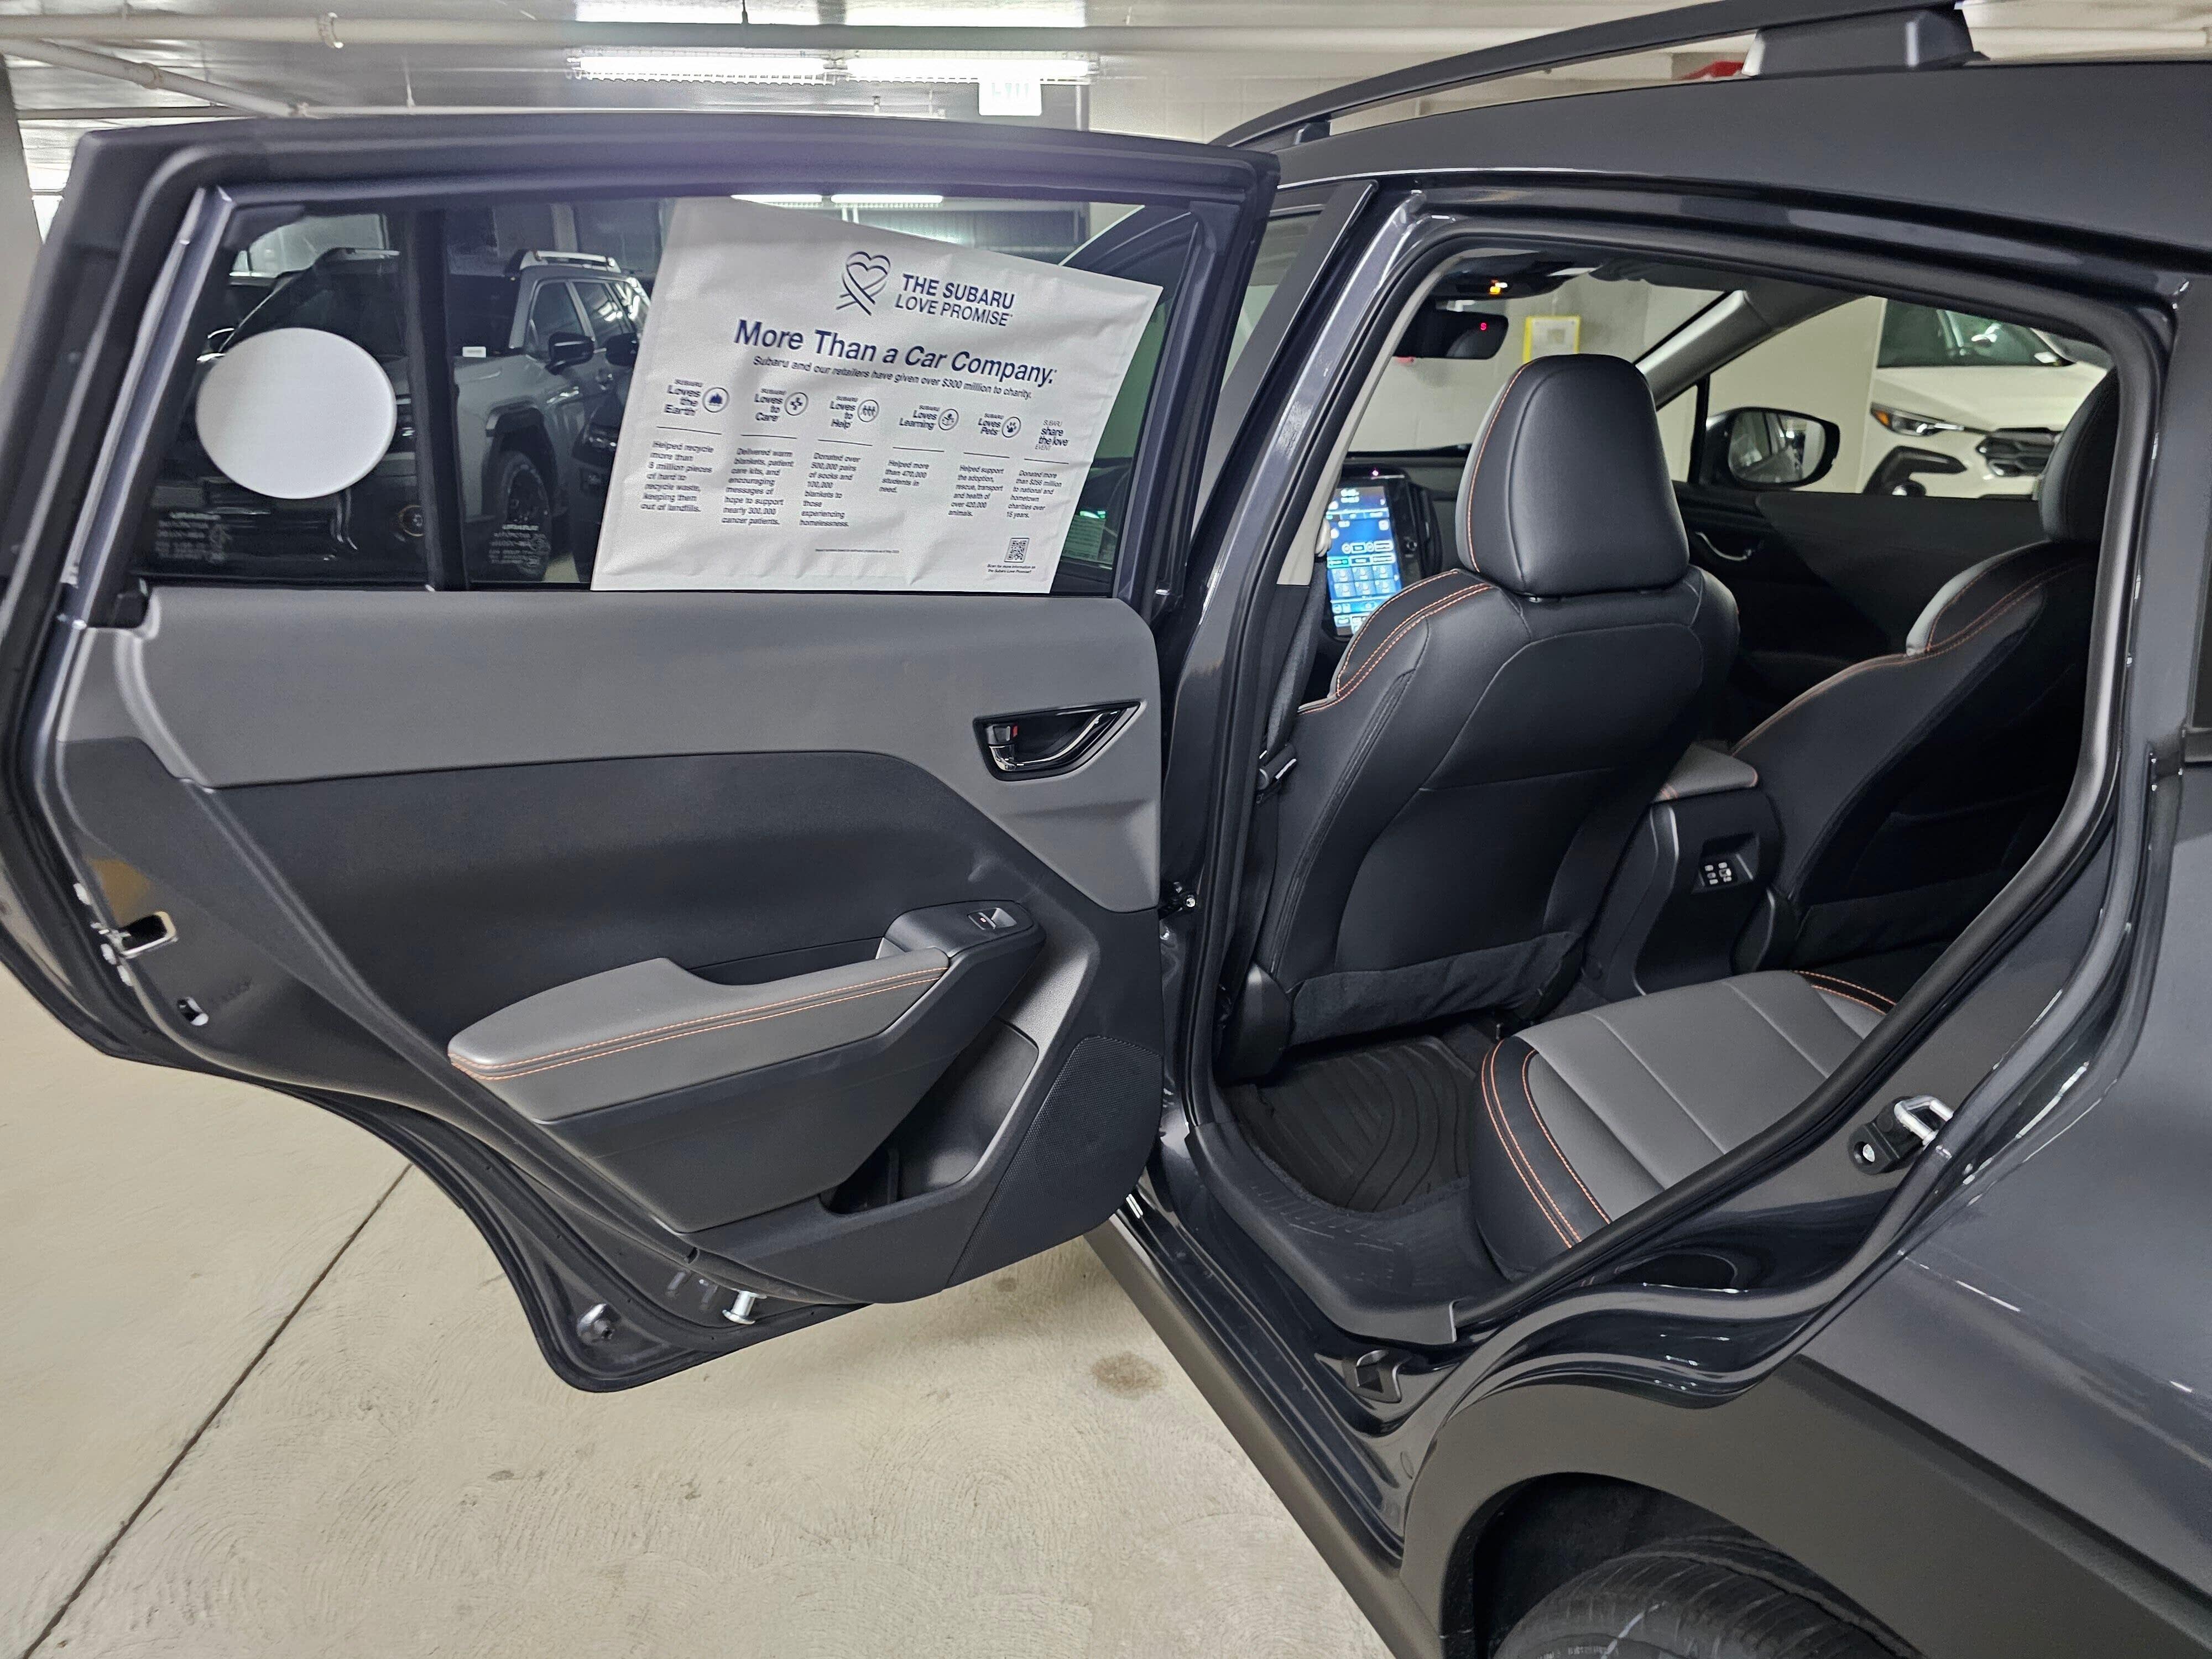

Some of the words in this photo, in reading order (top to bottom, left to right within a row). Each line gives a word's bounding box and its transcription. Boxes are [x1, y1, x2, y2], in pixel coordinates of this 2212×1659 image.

[902, 274, 940, 296] THE
[942, 282, 1015, 310] SUBARU
[895, 294, 938, 315] LOVE
[733, 319, 804, 350] More
[815, 330, 876, 362] Than
[883, 347, 898, 364] a
[905, 346, 948, 369] Car
[753, 356, 789, 369] Subaru
[791, 362, 811, 371] and
[813, 365, 830, 374] our
[832, 367, 870, 378] retailers
[872, 370, 893, 380] have
[895, 373, 919, 384] given
[921, 377, 940, 385] over
[941, 377, 962, 389] $300
[964, 381, 991, 392] million
[993, 385, 1001, 394] to
[1004, 387, 1031, 399] charity.
[675, 379, 703, 388] SUBARU
[667, 385, 701, 397] Loves
[680, 398, 698, 406] the
[754, 394, 783, 404] Loves
[664, 404, 696, 416] Earth
[830, 401, 855, 411] Loves
[755, 412, 779, 421] Care
[912, 410, 937, 420] Loves
[831, 419, 852, 430] Help
[899, 418, 936, 430] Learning
[978, 418, 1001, 428] Loves
[980, 426, 998, 436] Pets
[1041, 427, 1063, 437] share
[1038, 436, 1051, 445] the
[1052, 437, 1068, 446] love
[653, 441, 683, 451] Helped
[684, 444, 714, 453] recycle
[813, 452, 843, 462] Donated
[768, 460, 794, 468] patient
[888, 460, 911, 469] Helped
[959, 465, 980, 473] Helped
[728, 477, 775, 486] encouraging
[881, 477, 911, 486] students
[643, 493, 676, 502] keeping
[667, 504, 701, 512] landfills.
[723, 507, 745, 515] nearly
[801, 510, 845, 519] experiencing
